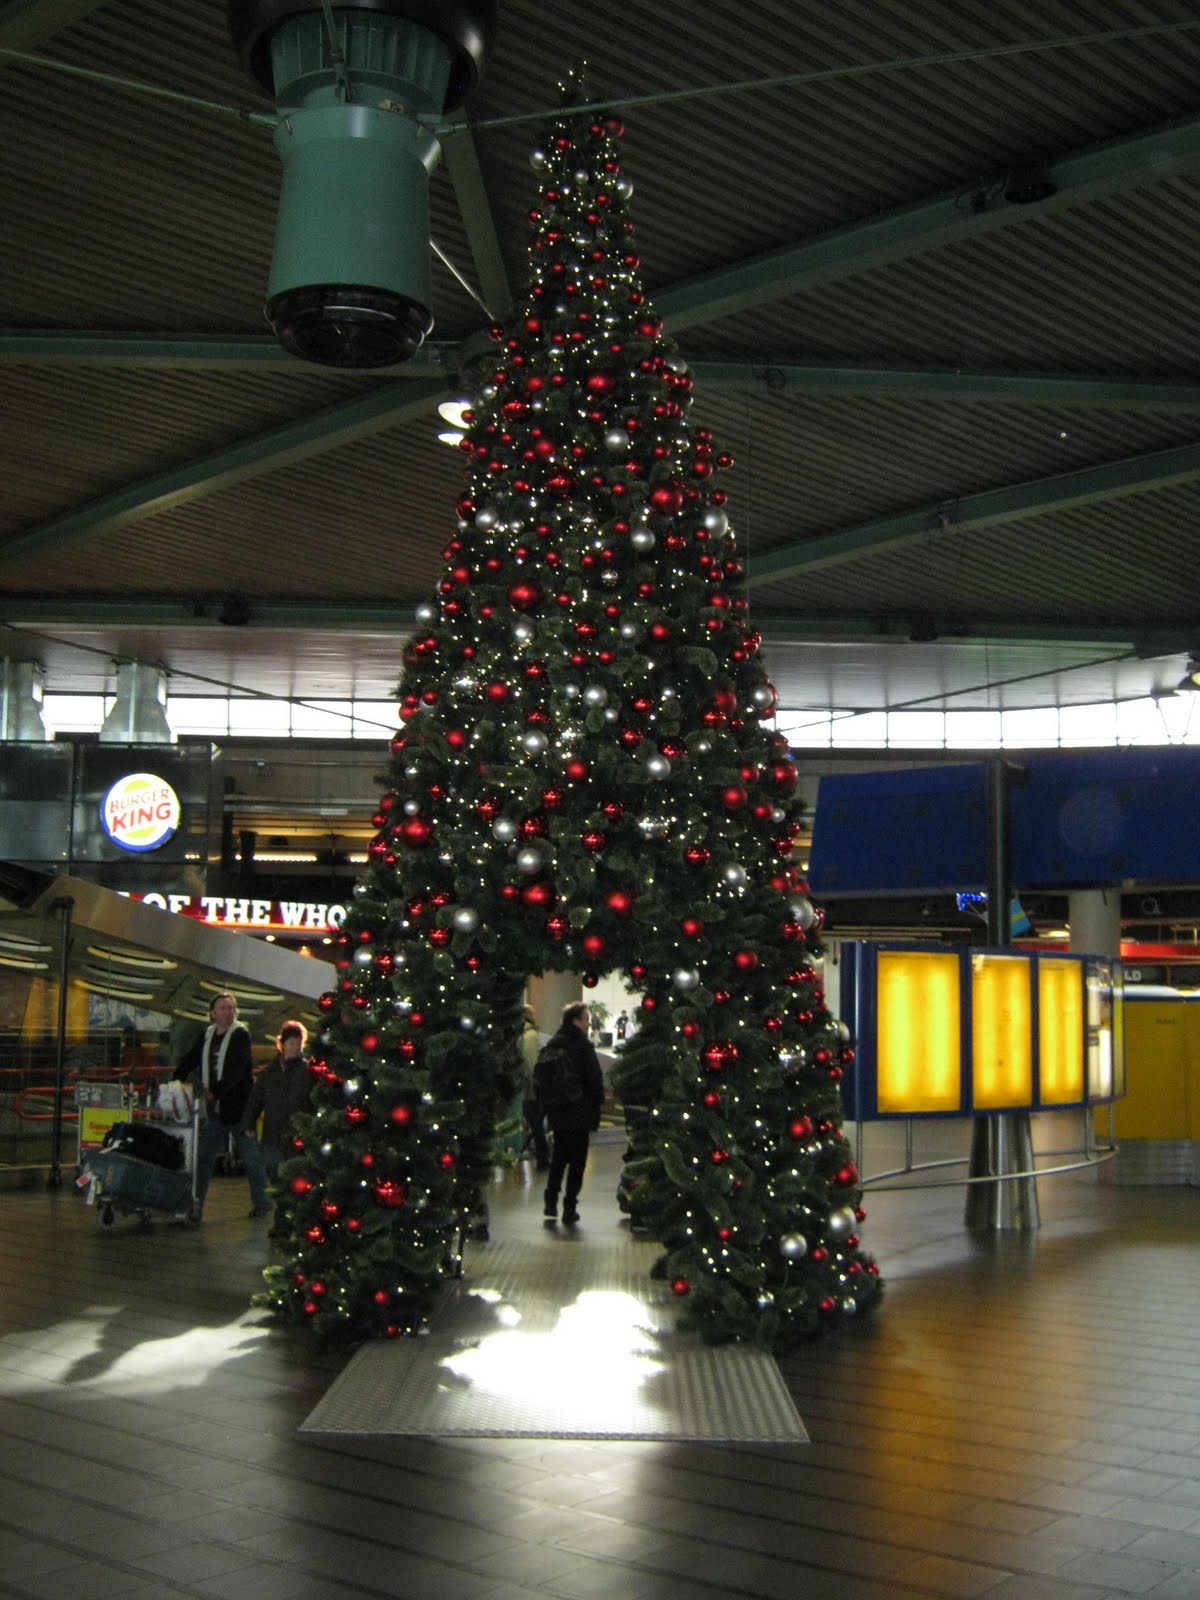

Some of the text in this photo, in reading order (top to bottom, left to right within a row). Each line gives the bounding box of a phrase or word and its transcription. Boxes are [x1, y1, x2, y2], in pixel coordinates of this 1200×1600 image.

[110, 788, 169, 814] BURGER
[112, 802, 171, 833] KING
[200, 896, 272, 924] THE
